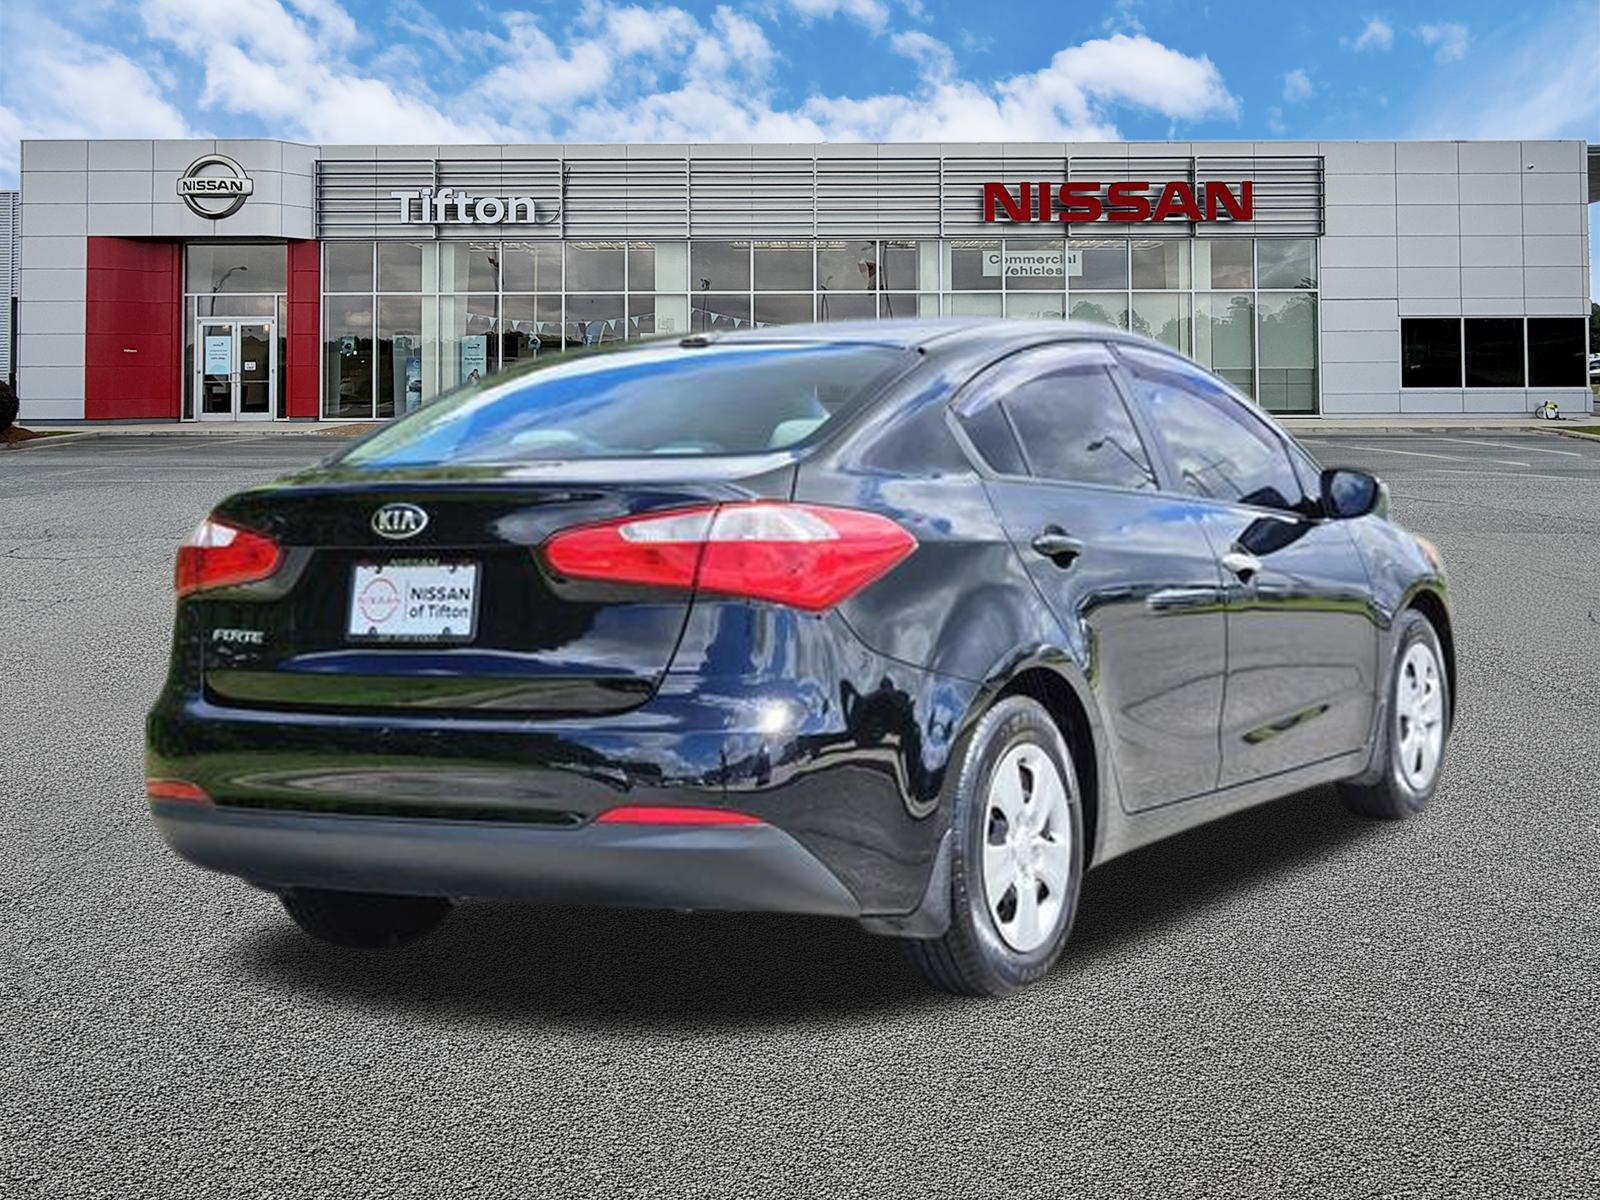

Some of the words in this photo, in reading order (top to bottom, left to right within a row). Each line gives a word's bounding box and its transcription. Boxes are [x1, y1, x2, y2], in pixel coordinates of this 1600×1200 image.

[182, 180, 243, 191] NISSAN
[390, 188, 536, 224] Tifton
[983, 180, 1254, 222] NISSAN
[379, 510, 416, 530] KIA
[410, 587, 470, 601] NISSAN
[409, 604, 424, 618] of
[427, 604, 468, 618] Tifton
